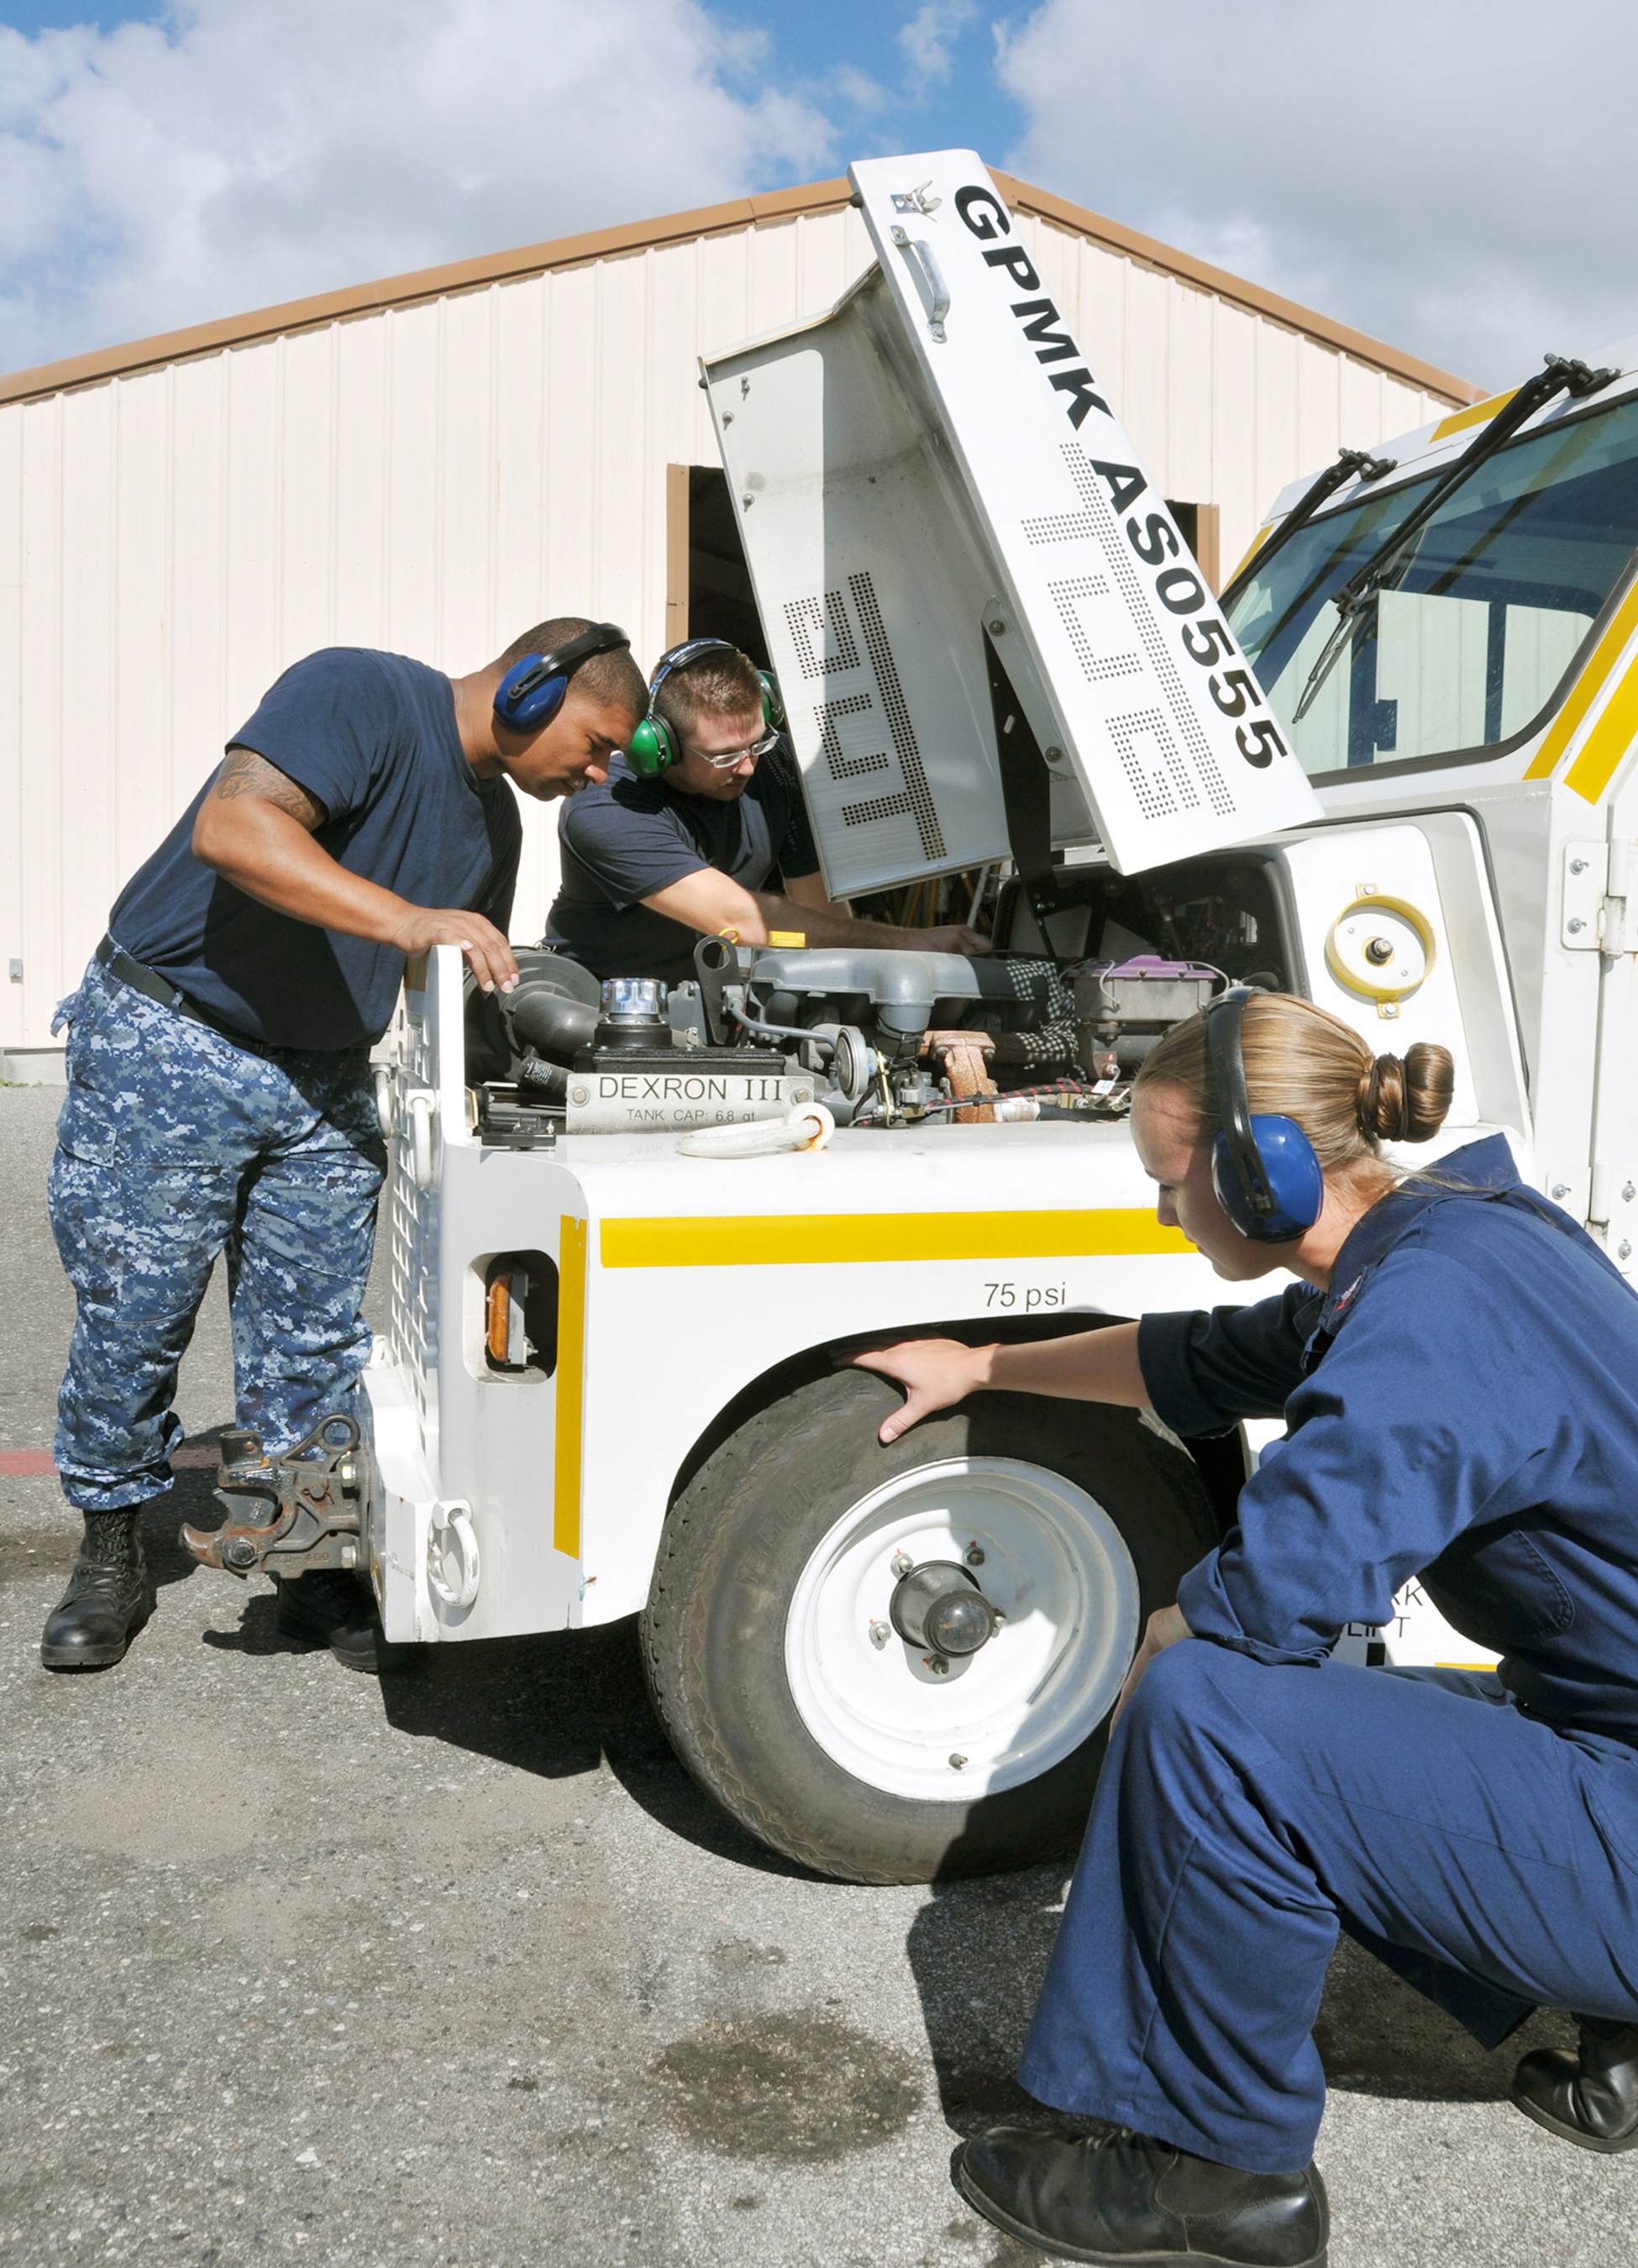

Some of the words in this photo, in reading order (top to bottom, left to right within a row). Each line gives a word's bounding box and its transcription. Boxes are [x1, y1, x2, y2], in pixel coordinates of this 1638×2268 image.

[953, 184, 1116, 432] GPMK
[599, 1076, 727, 1100] DEXRON
[743, 1078, 783, 1101] III
[626, 1108, 665, 1121] TANK
[673, 1108, 708, 1122] CAP:
[716, 1110, 735, 1122] 6.8
[984, 1283, 1016, 1307] 75
[1026, 1281, 1066, 1312] psi
